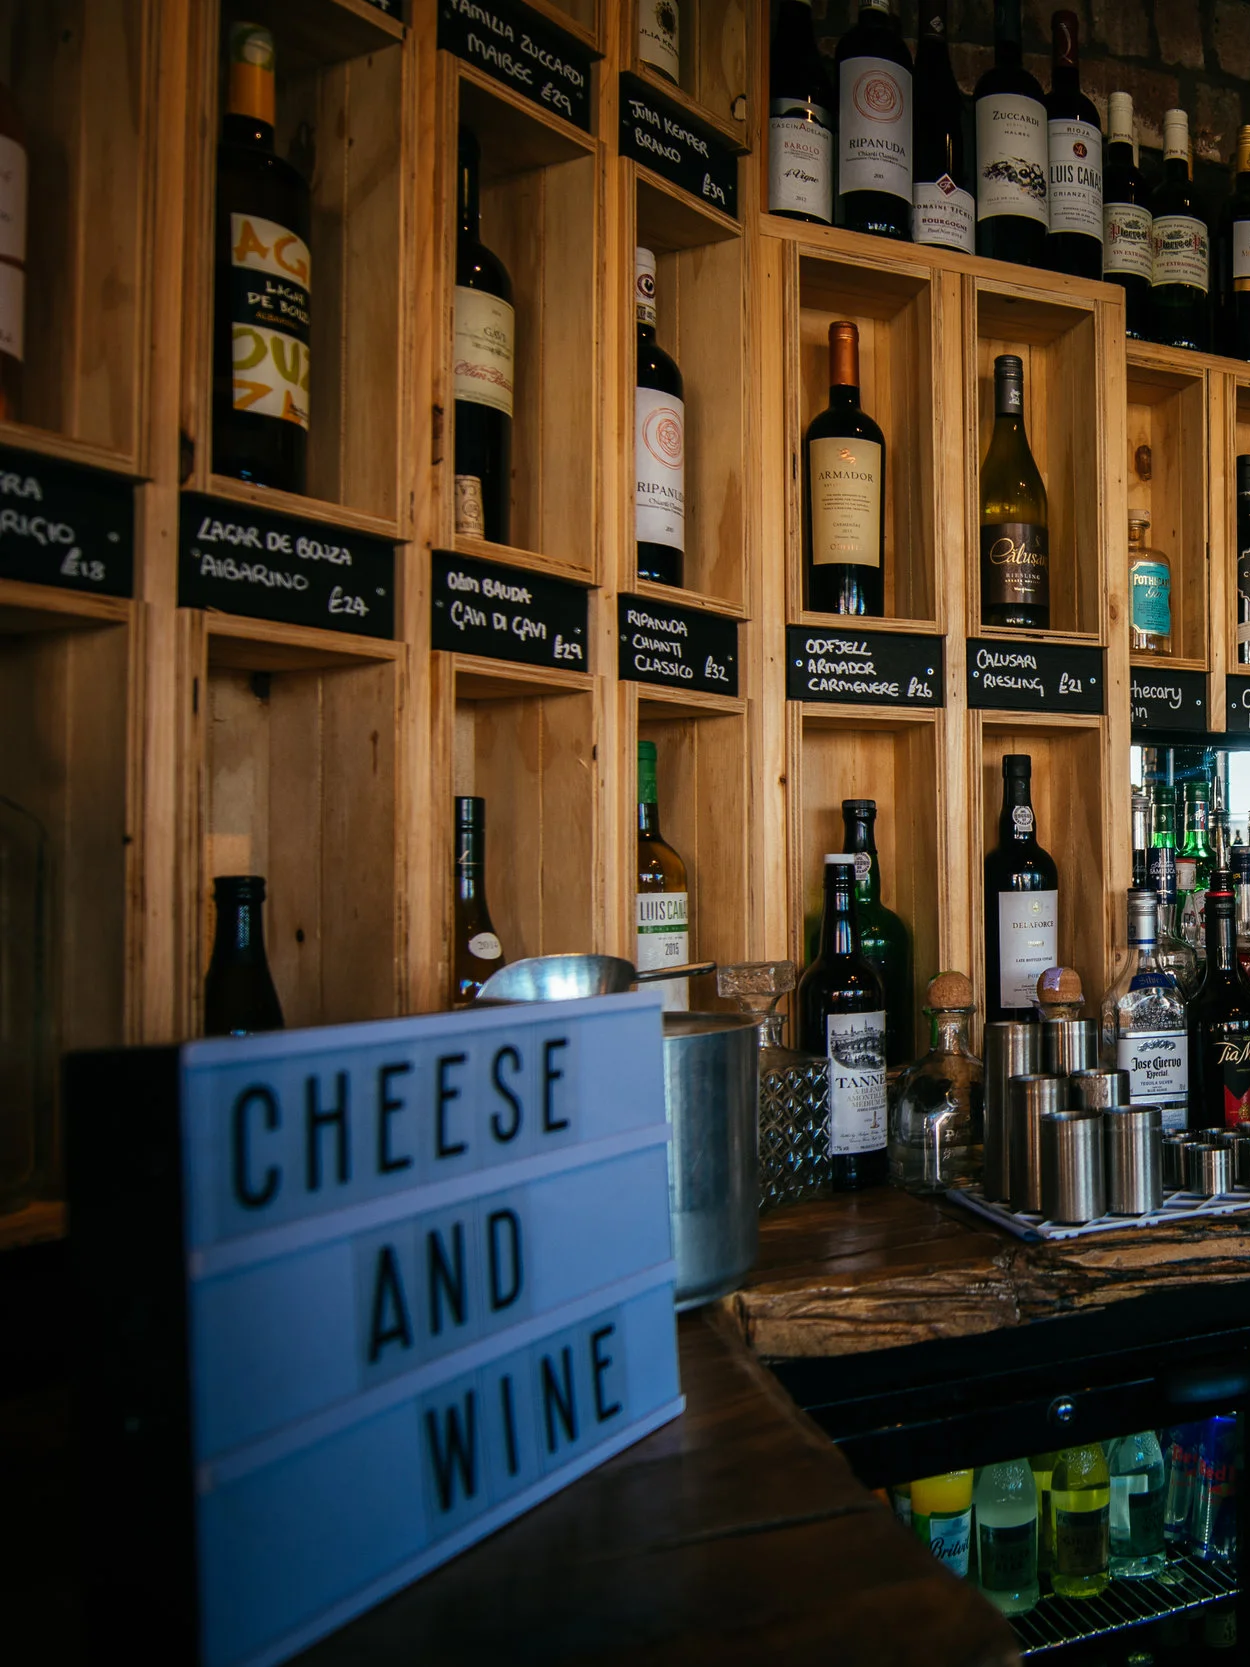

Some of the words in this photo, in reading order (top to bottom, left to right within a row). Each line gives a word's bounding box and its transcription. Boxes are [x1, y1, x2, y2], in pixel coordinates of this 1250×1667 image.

[520, 34, 584, 88] ZUCCARDI
[541, 83, 572, 116] £29
[992, 110, 1040, 128] ZUCCARDI
[1066, 126, 1091, 137] RIOJA
[784, 141, 820, 155] BAROLO
[849, 137, 906, 157] RIPANUDA
[1050, 165, 1074, 184] LUIS
[702, 173, 725, 205] £39
[1053, 190, 1087, 198] CRIANZA
[922, 218, 967, 231] BOURGOGNE
[247, 292, 273, 309] DE
[819, 471, 874, 483] ARMADOR
[266, 531, 292, 554] DE
[295, 537, 353, 566] BOUZA
[60, 547, 106, 581] £18
[328, 586, 370, 617] £24
[482, 578, 533, 605] BAUDA
[493, 612, 508, 631] DI
[627, 609, 688, 637] RIPANUDA
[553, 634, 583, 660] £29
[633, 633, 682, 658] CHIANTI
[705, 655, 729, 682] £32
[806, 638, 872, 656] ODFJELL
[634, 654, 693, 680] CLASSICO
[807, 658, 877, 675] ARMADOR
[976, 649, 1037, 669] CALUSARI
[808, 678, 899, 697] CARMENERE
[907, 676, 932, 698] £26
[983, 675, 1044, 697] RIESLING
[1059, 672, 1082, 694] £21
[640, 901, 665, 921] LUIS
[1012, 920, 1054, 929] DELAFORCE
[665, 943, 679, 956] 2015
[1212, 1041, 1240, 1065] Tia
[1131, 1057, 1152, 1072] Jose
[1153, 1056, 1182, 1069] Cuervo
[231, 1037, 570, 1211] CHEESE
[368, 1207, 525, 1364] AND
[424, 1323, 622, 1514] WINE
